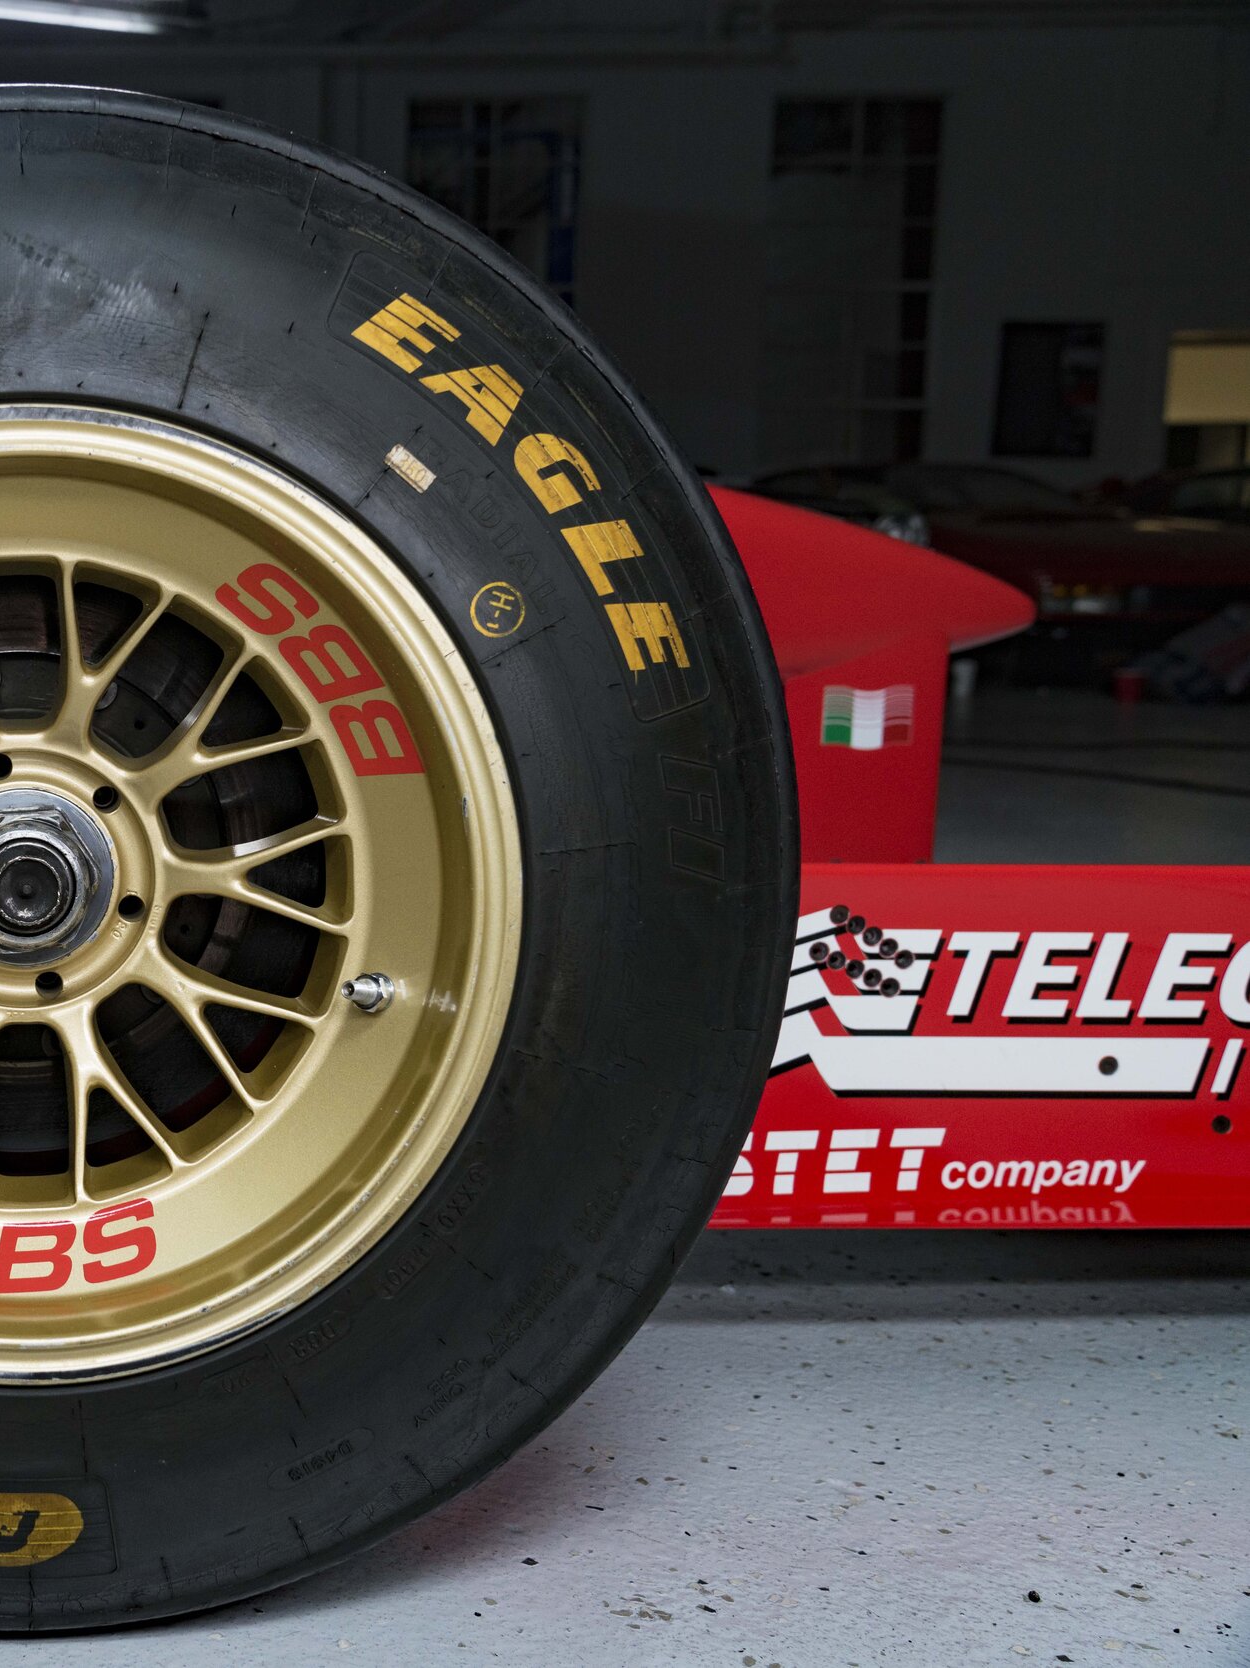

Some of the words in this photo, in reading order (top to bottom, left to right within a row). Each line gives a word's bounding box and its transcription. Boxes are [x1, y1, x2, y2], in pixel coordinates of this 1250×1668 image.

[351, 293, 690, 673] EAGLE
[216, 563, 423, 776] BBS
[940, 1158, 1147, 1195] company
